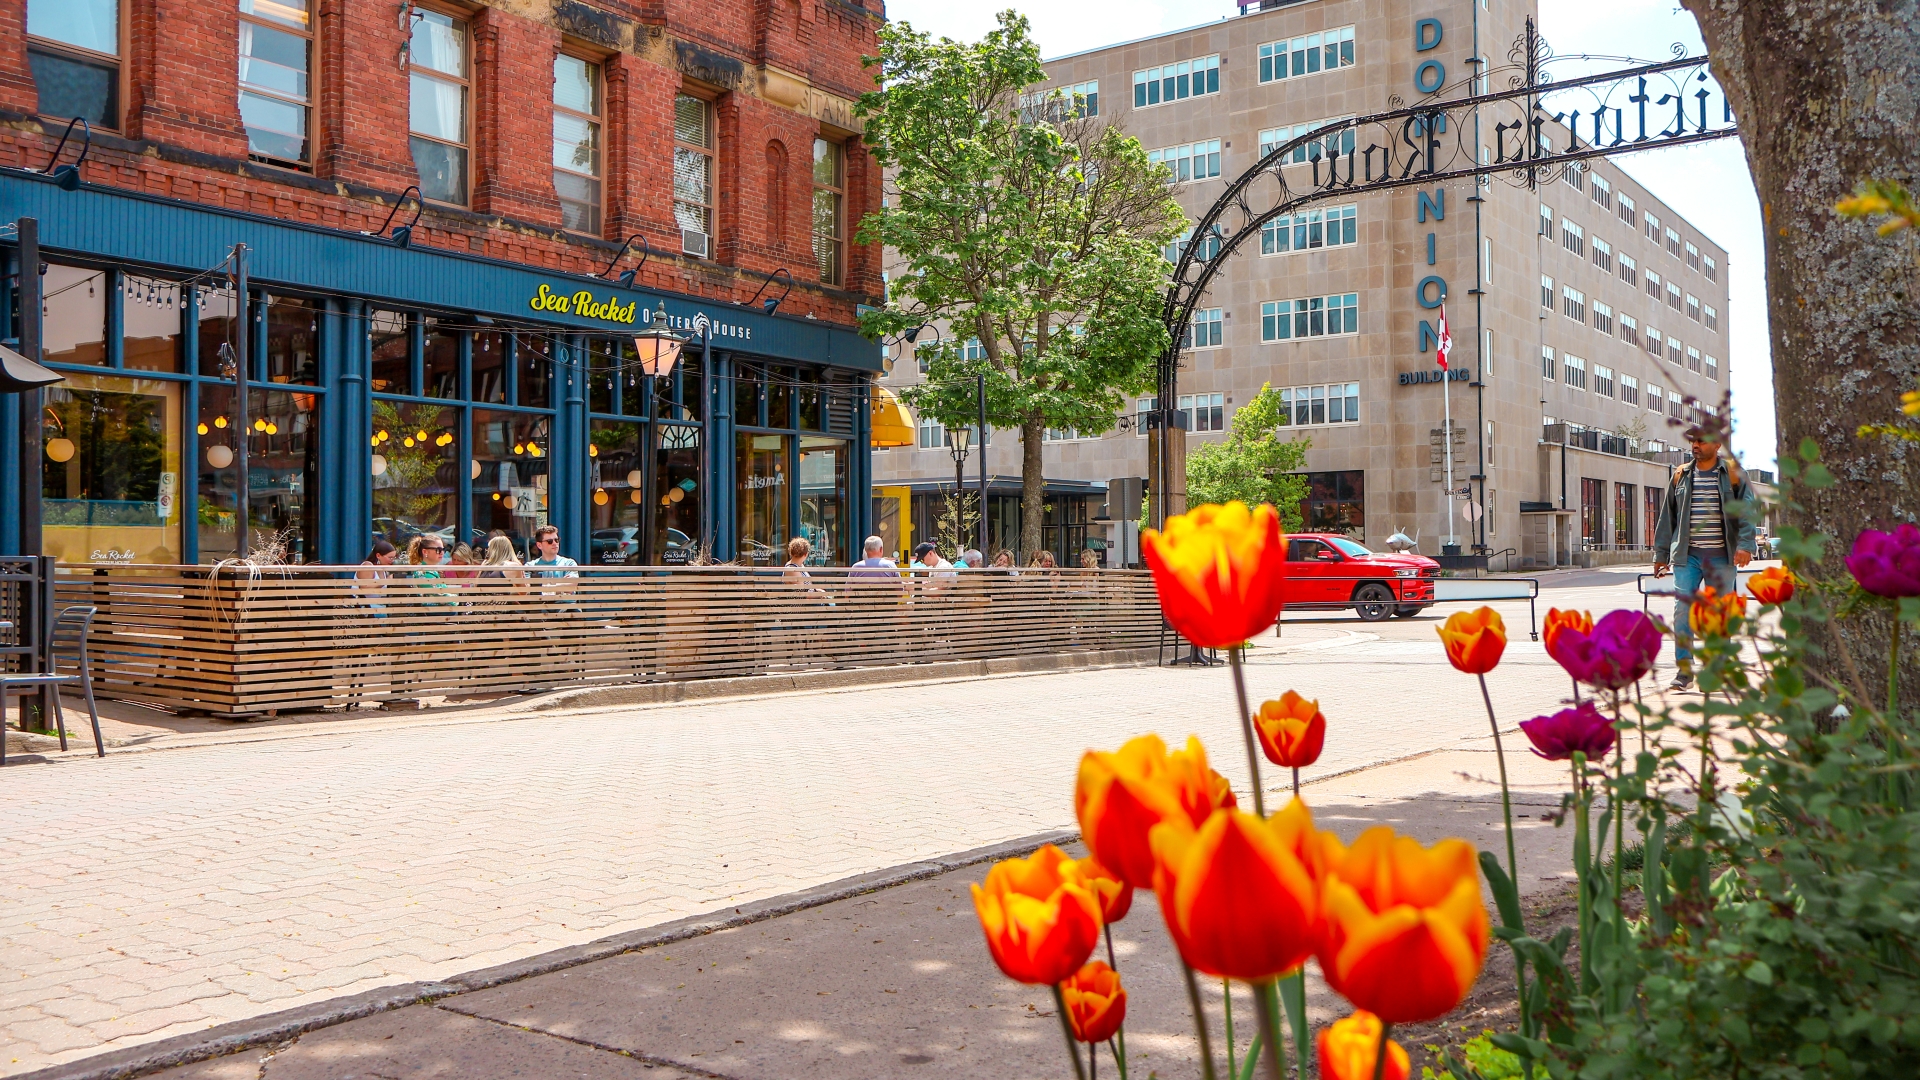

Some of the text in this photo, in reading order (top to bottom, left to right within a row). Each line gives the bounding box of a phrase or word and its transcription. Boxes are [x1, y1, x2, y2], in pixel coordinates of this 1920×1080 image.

[530, 283, 751, 339] Sea Rocket OTER HOUSE
[1398, 368, 1470, 385] BUILDNG
[90, 549, 136, 560] Sea Rocket
